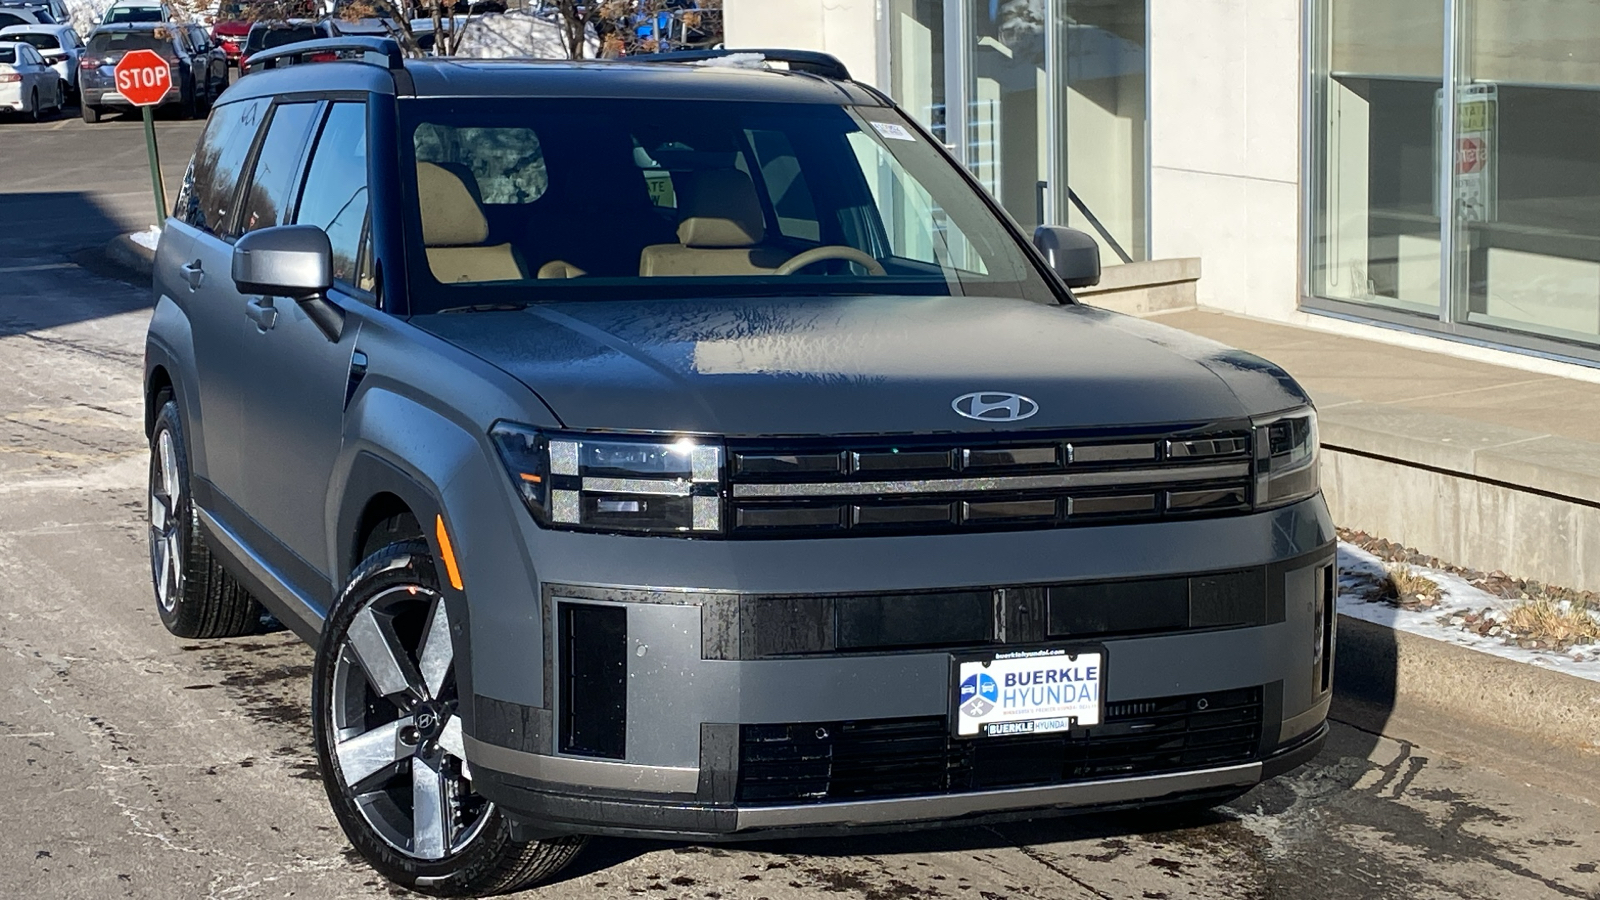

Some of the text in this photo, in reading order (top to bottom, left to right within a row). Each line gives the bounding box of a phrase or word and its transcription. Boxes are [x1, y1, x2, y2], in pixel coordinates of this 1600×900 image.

[119, 66, 167, 89] STOP
[1004, 666, 1097, 687] BUERKLE
[1003, 683, 1097, 708] HYUNDAI
[990, 720, 1067, 735] BUERKLE HYUNDAI
